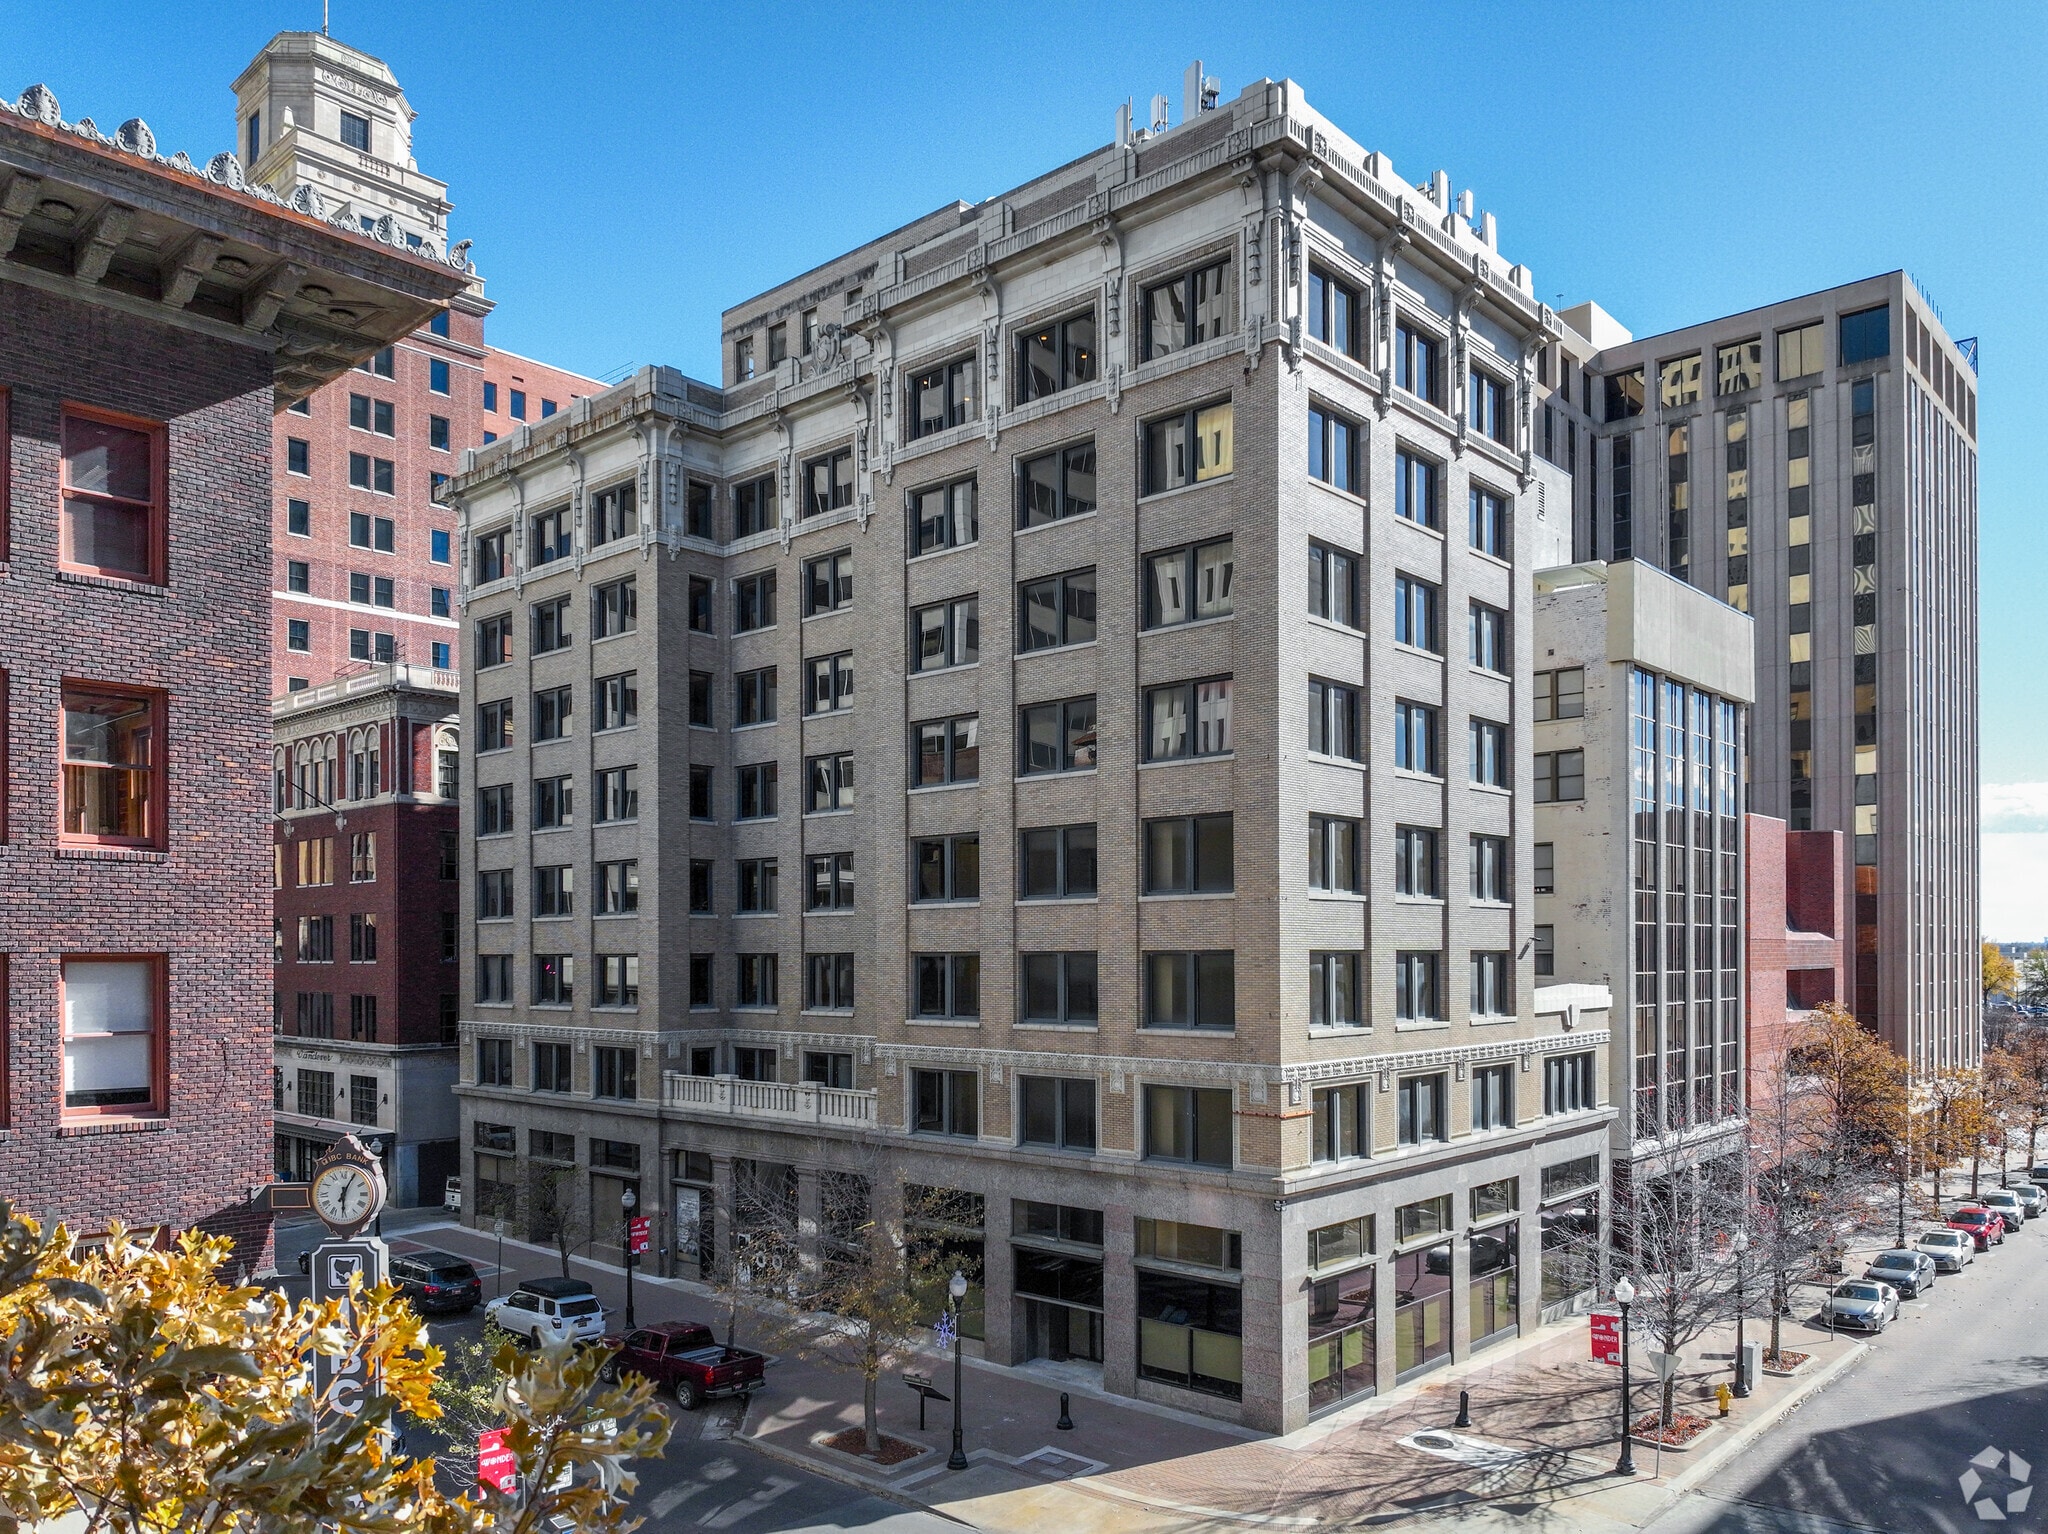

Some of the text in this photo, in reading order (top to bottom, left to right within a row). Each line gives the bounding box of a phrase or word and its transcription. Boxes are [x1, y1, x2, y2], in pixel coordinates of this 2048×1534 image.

[328, 1153, 369, 1165] IBC BANK
[480, 1453, 514, 1467] WONDER
